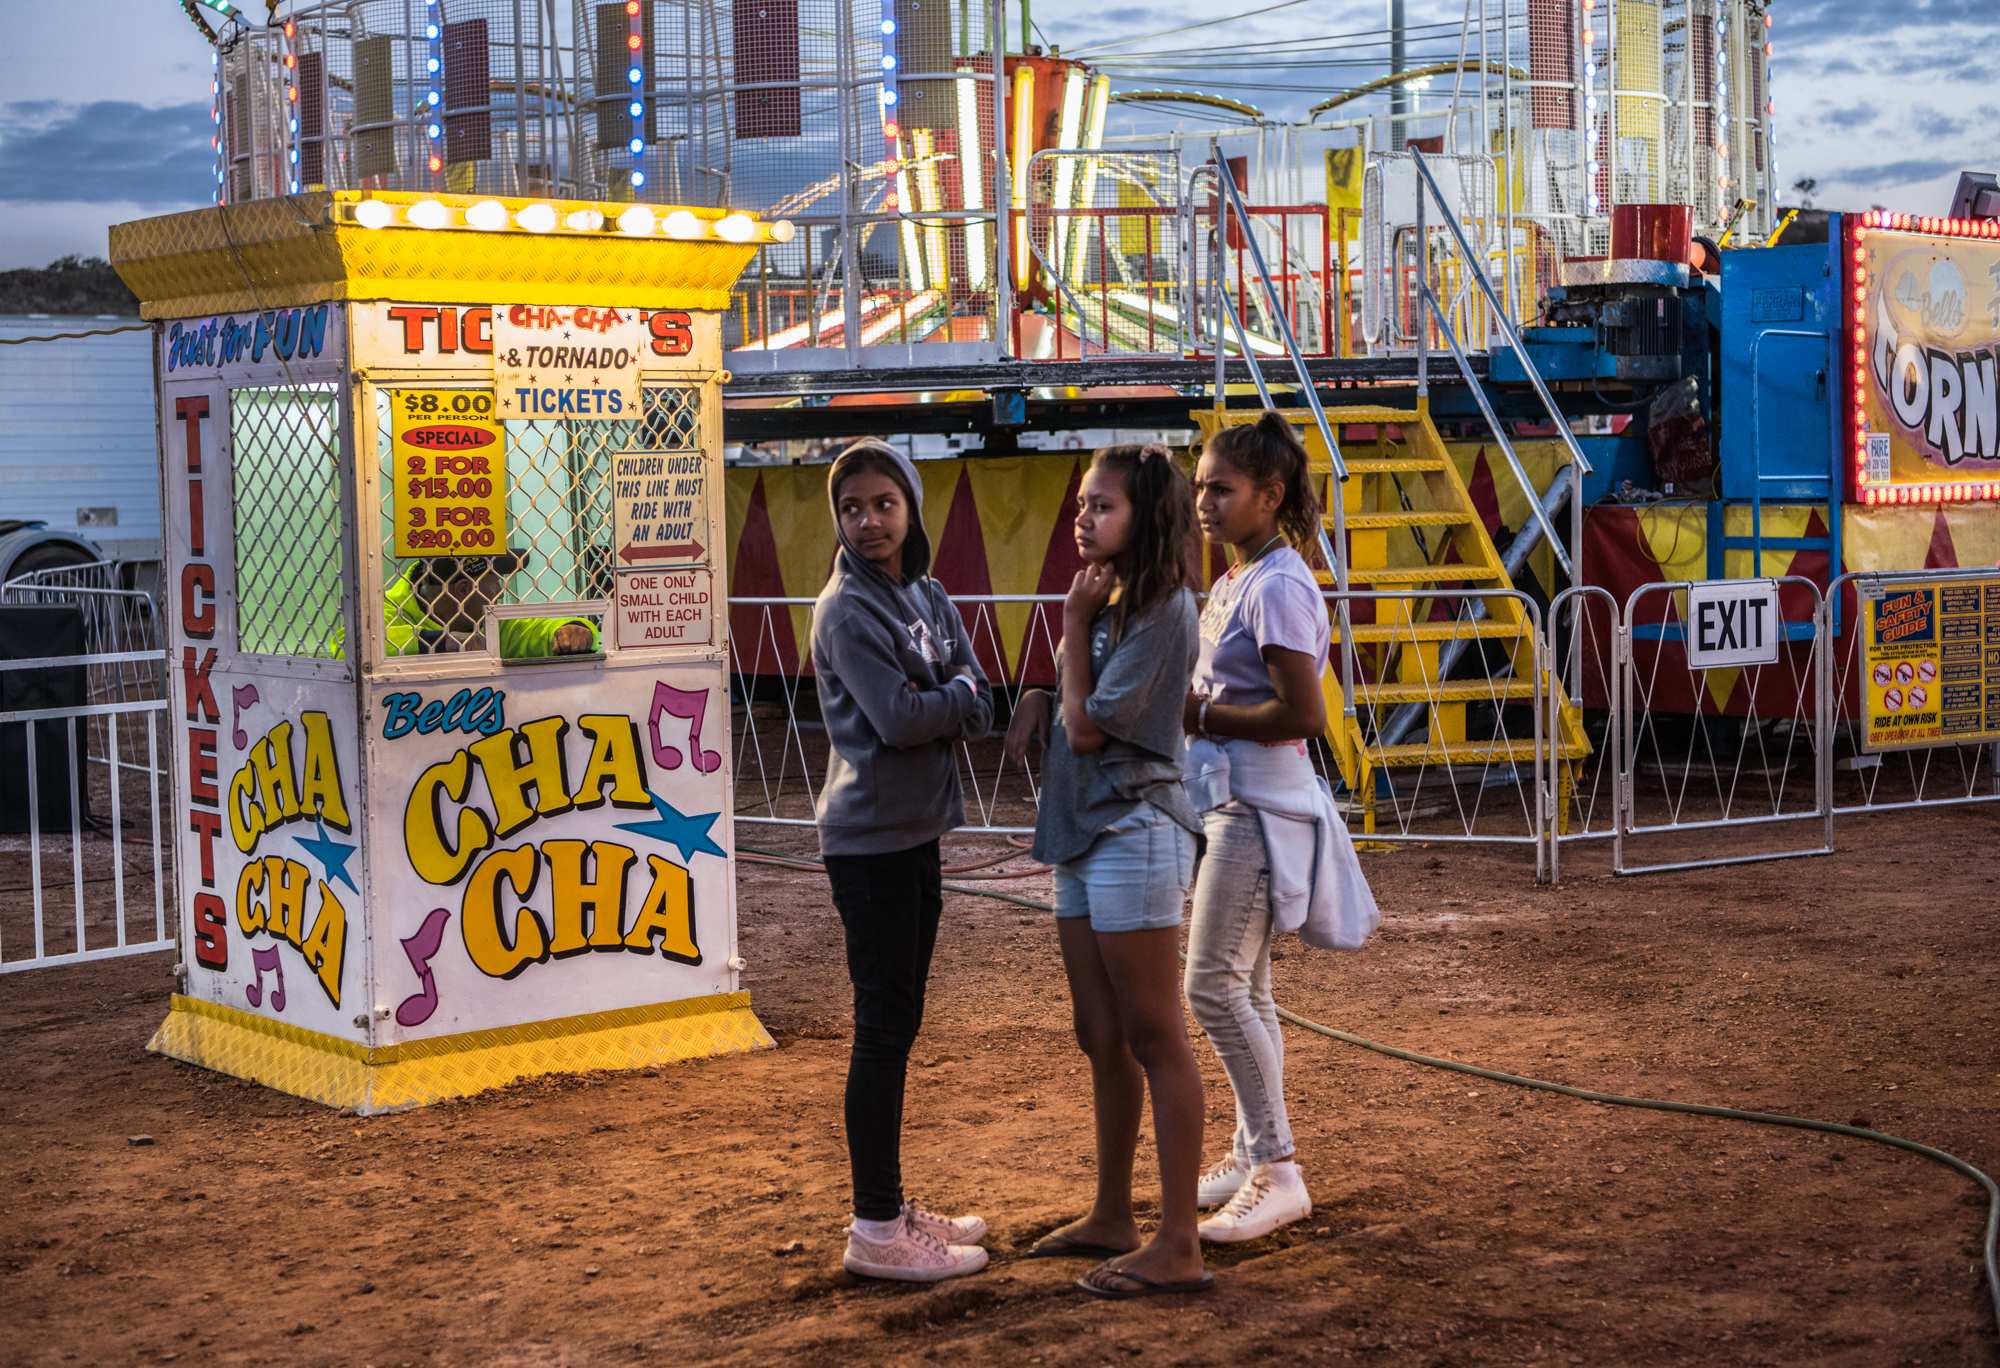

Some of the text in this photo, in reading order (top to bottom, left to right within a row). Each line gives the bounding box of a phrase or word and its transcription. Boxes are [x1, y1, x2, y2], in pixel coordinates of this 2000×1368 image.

[388, 306, 692, 356] TICS
[509, 305, 623, 334] CHA-CHA
[168, 317, 219, 373] Just
[251, 305, 328, 363] FUN
[507, 346, 629, 369] & TORNADO
[1873, 288, 2000, 465] TORN
[405, 394, 492, 414] $8.00
[515, 388, 623, 414] TICKETS
[415, 431, 482, 445] SPECIAL
[407, 455, 492, 475] 2 FOR
[617, 456, 702, 477] CHILDREN UNDER
[408, 476, 492, 499] $15.00
[616, 478, 704, 498] THIS LINE MUST
[408, 506, 493, 528] 3 FOR
[631, 500, 691, 520] RIDE WITH
[407, 528, 495, 549] $20.00
[632, 522, 694, 542] AN ADULT
[630, 575, 696, 590] ONE ONLY
[620, 592, 708, 607] SMALL CHILD
[1882, 594, 1912, 616] FUN
[627, 608, 701, 623] WITH EACH
[1698, 598, 1768, 651] EXIT
[1876, 600, 1933, 631] SAFETY
[644, 625, 686, 639] ADULT
[1882, 616, 1927, 643] GUIDE
[175, 395, 229, 974] TICKETS
[382, 686, 506, 741] Bells
[1874, 711, 1937, 728] RIDE AT OWN RISK
[228, 710, 352, 856] CHA
[404, 714, 656, 886] CHA
[461, 839, 702, 981] CHA
[235, 854, 348, 1011] CHA
